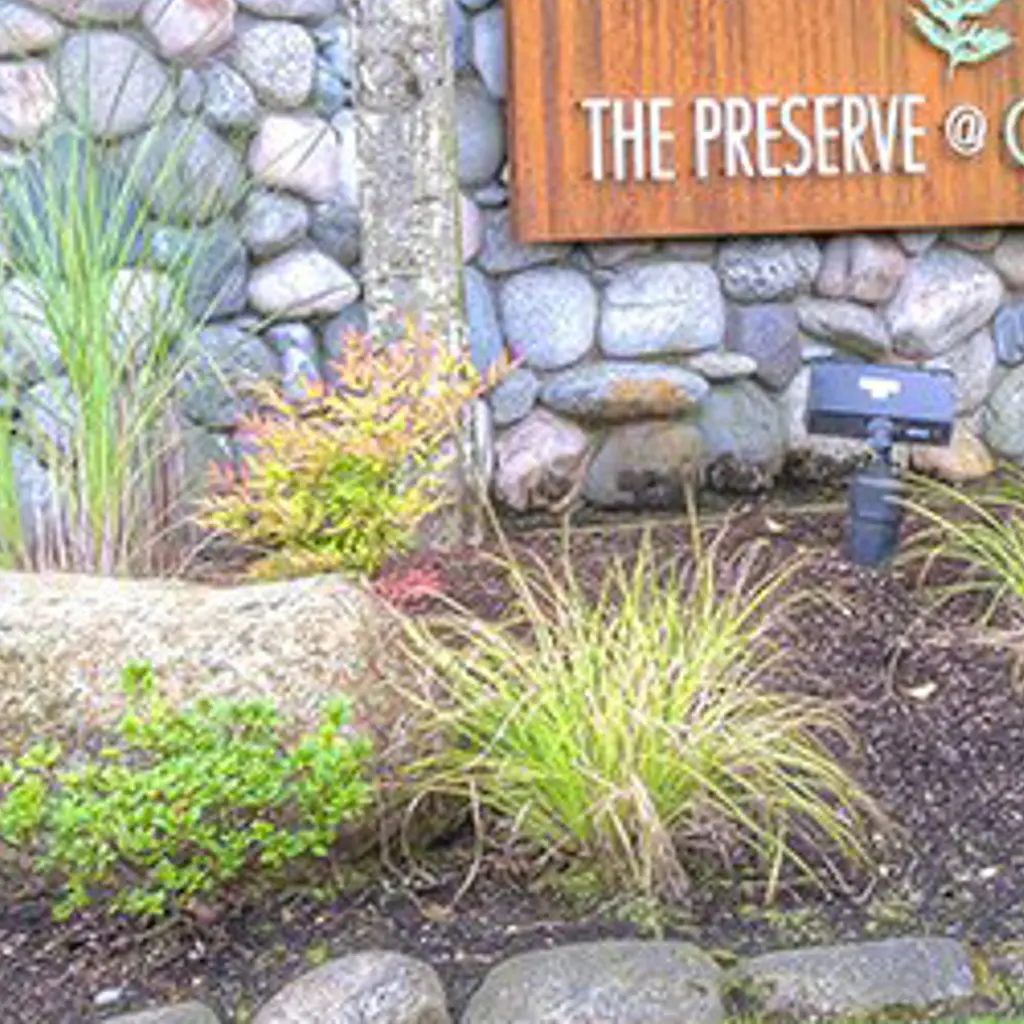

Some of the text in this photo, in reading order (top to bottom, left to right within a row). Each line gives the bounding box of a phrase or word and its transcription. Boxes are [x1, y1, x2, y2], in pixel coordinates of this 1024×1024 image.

[583, 97, 675, 182] THE
[694, 93, 926, 179] PRESERVE
[944, 106, 986, 157] @
